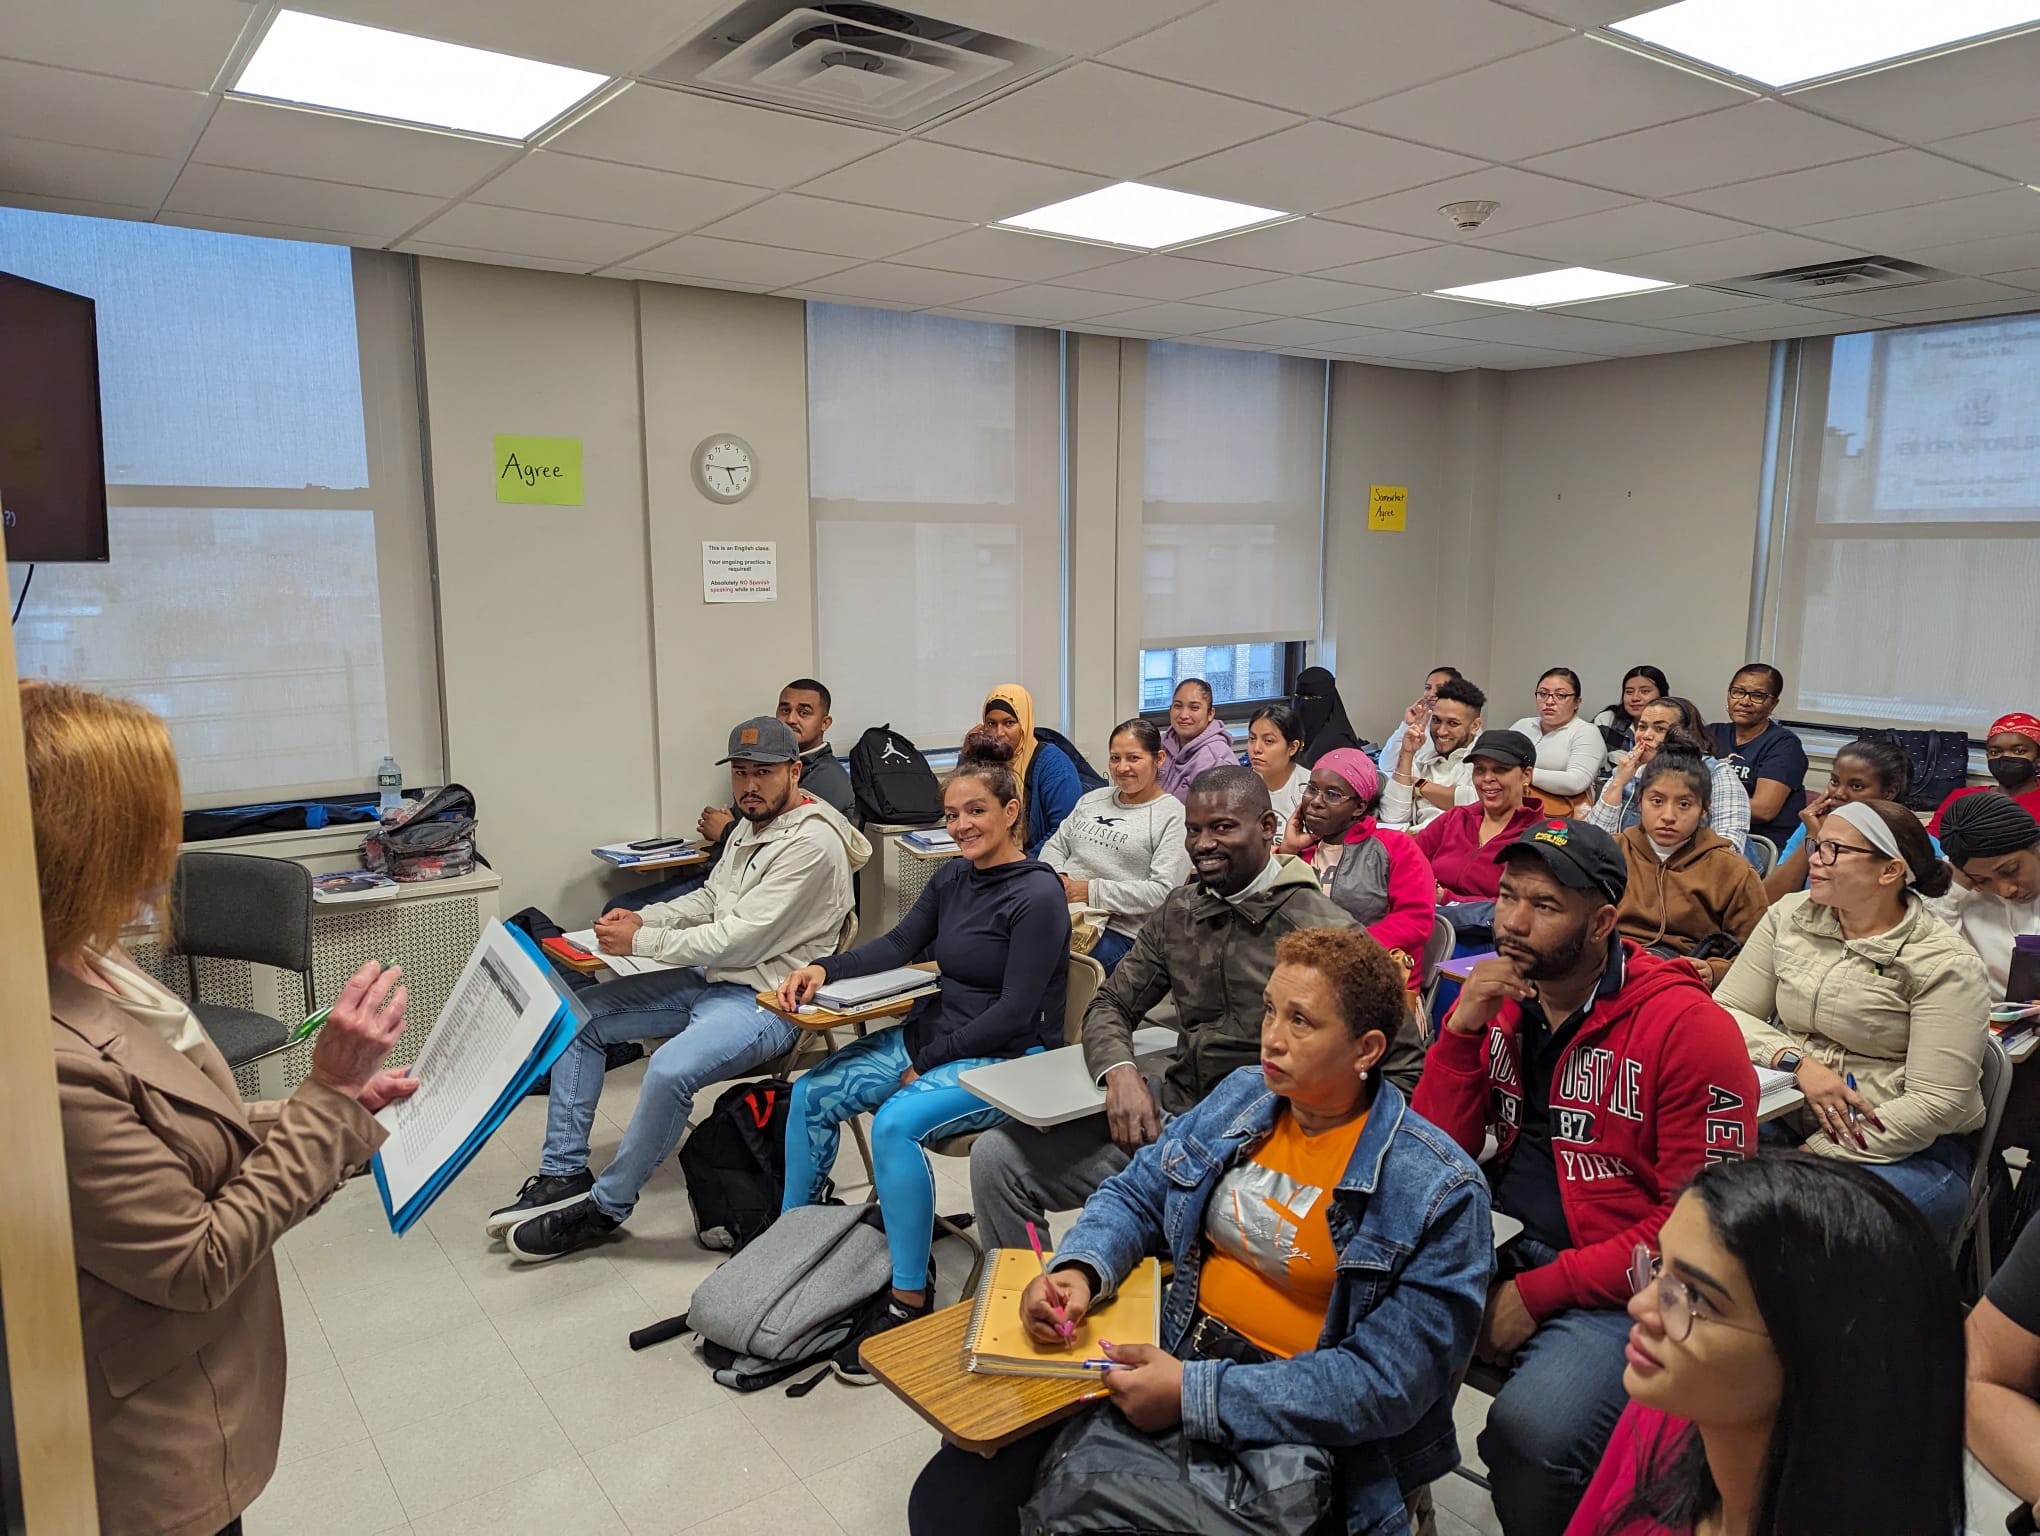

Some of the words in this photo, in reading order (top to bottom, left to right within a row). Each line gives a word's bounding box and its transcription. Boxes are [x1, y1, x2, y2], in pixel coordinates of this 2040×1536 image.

[707, 453, 714, 461] 10
[501, 452, 564, 487] Agree
[1374, 487, 1405, 502] Somewhat
[1375, 505, 1395, 521] Agree
[1730, 764, 1750, 778] ER
[1560, 1111, 1587, 1141] 87
[1560, 1150, 1634, 1181] YORK
